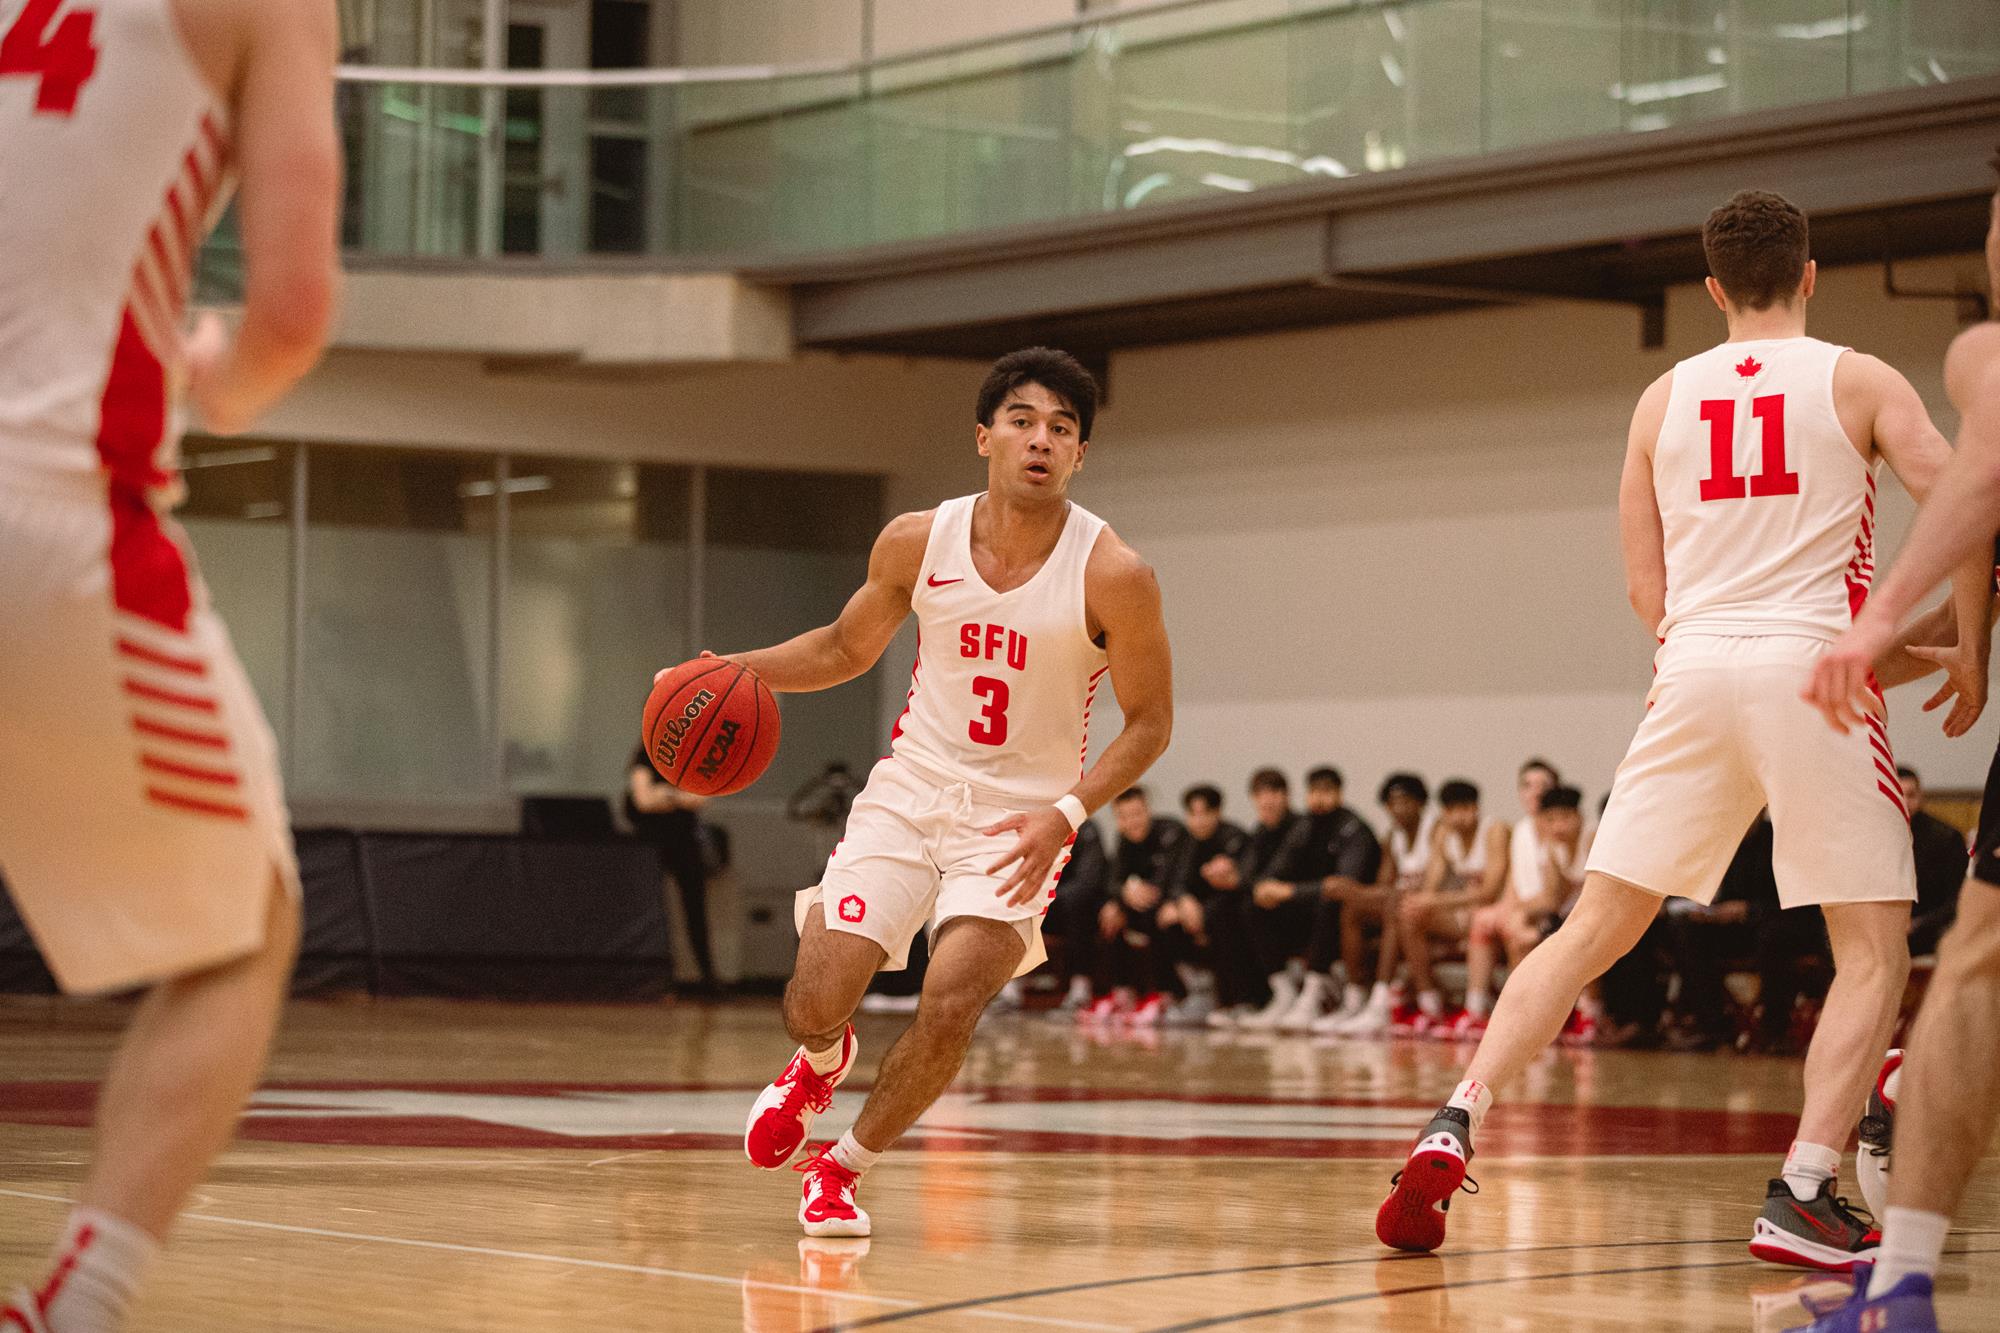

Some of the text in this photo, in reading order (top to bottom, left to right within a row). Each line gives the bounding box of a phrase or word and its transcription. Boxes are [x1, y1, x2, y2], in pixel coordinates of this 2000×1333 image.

[0, 0, 98, 115] 4
[1699, 393, 1799, 502] 11
[960, 623, 1028, 671] SFU
[656, 688, 716, 768] Wilson
[968, 675, 1010, 746] 3
[696, 719, 741, 781] NCAA
